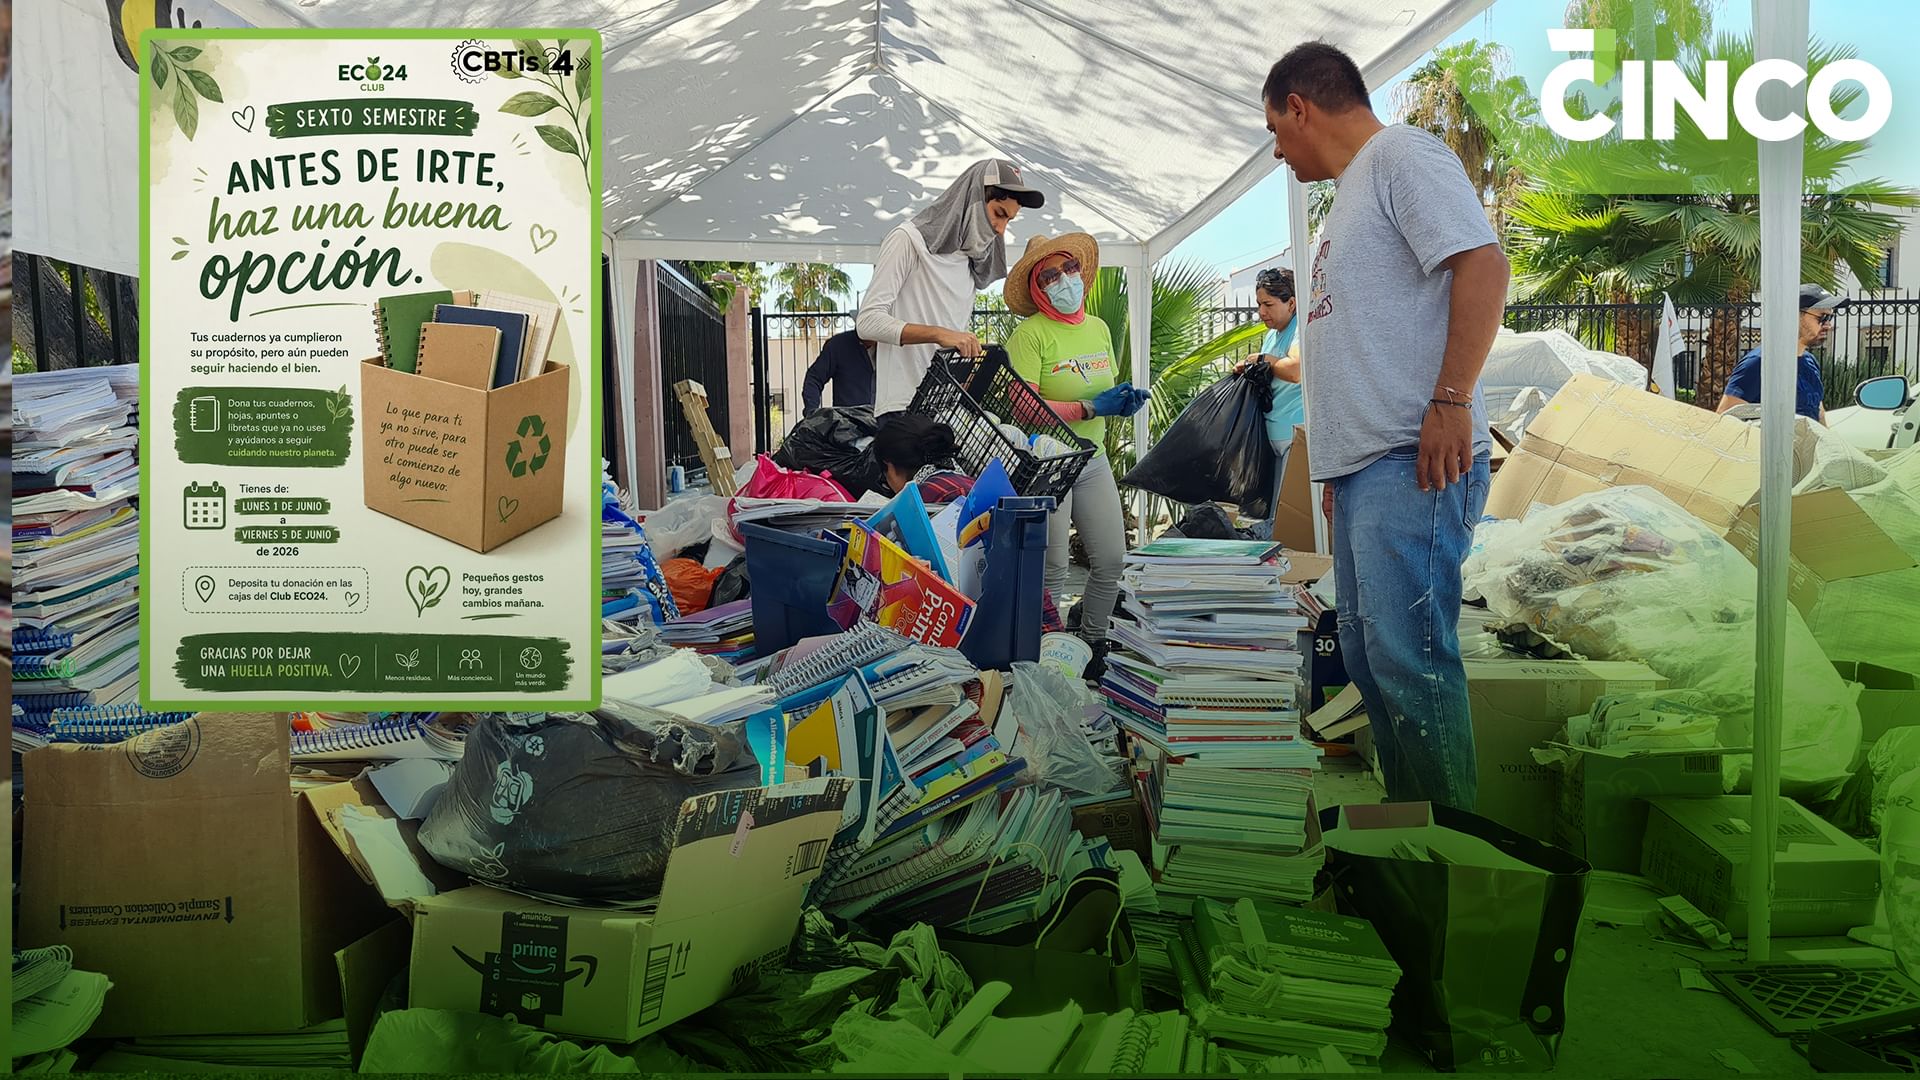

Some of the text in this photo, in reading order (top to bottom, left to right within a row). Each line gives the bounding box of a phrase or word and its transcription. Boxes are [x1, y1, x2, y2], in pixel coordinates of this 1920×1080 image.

[1315, 638, 1336, 652] 30
[768, 717, 777, 765] Alimentos
[1499, 763, 1548, 774] YOUNG
[69, 898, 220, 916] Sample Collection Containers
[69, 912, 220, 927] ENVIRONMENTAL EXPRESS
[521, 912, 552, 923] anuncios
[512, 939, 558, 959] prime
